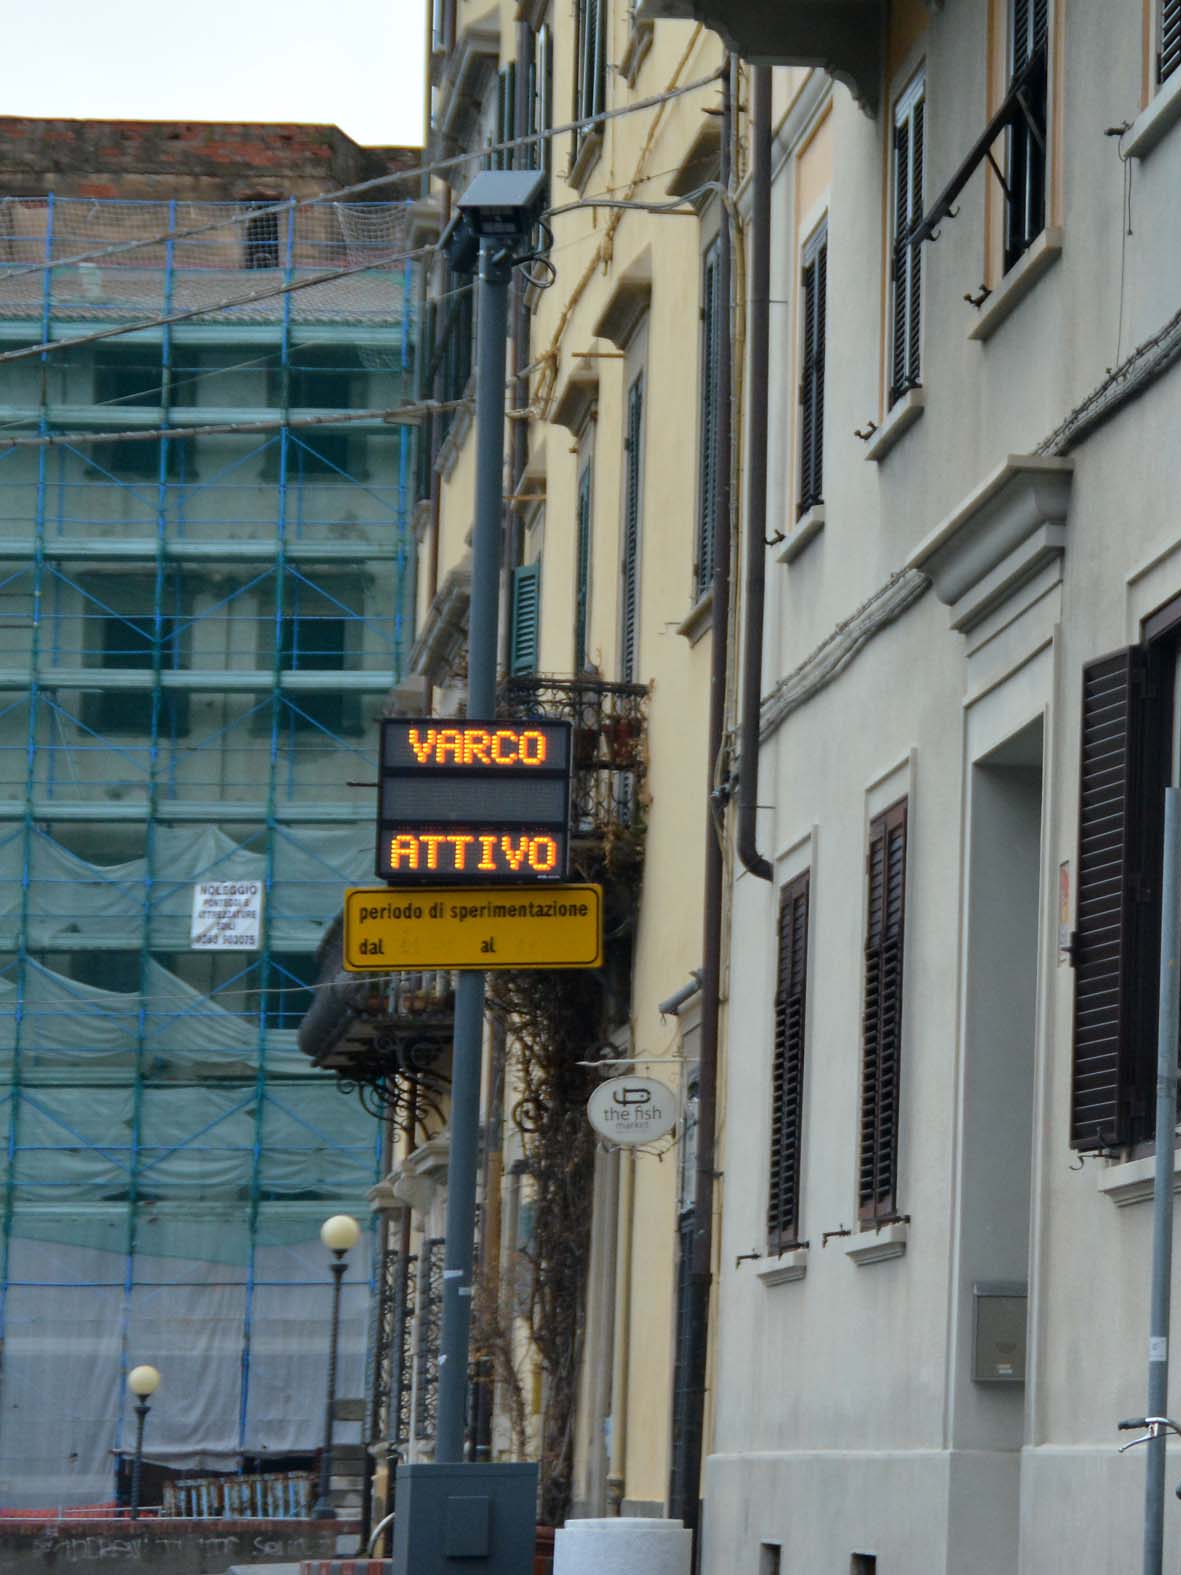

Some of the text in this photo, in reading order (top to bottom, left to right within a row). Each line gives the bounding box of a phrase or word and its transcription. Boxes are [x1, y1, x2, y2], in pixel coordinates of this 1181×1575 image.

[408, 729, 547, 766] VARCO
[390, 835, 557, 871] ATTIVO
[200, 885, 257, 895] NOLEGGIO
[359, 902, 588, 923] periodo di sperimentazione
[359, 940, 384, 955] dal
[603, 1105, 662, 1121] the fish
